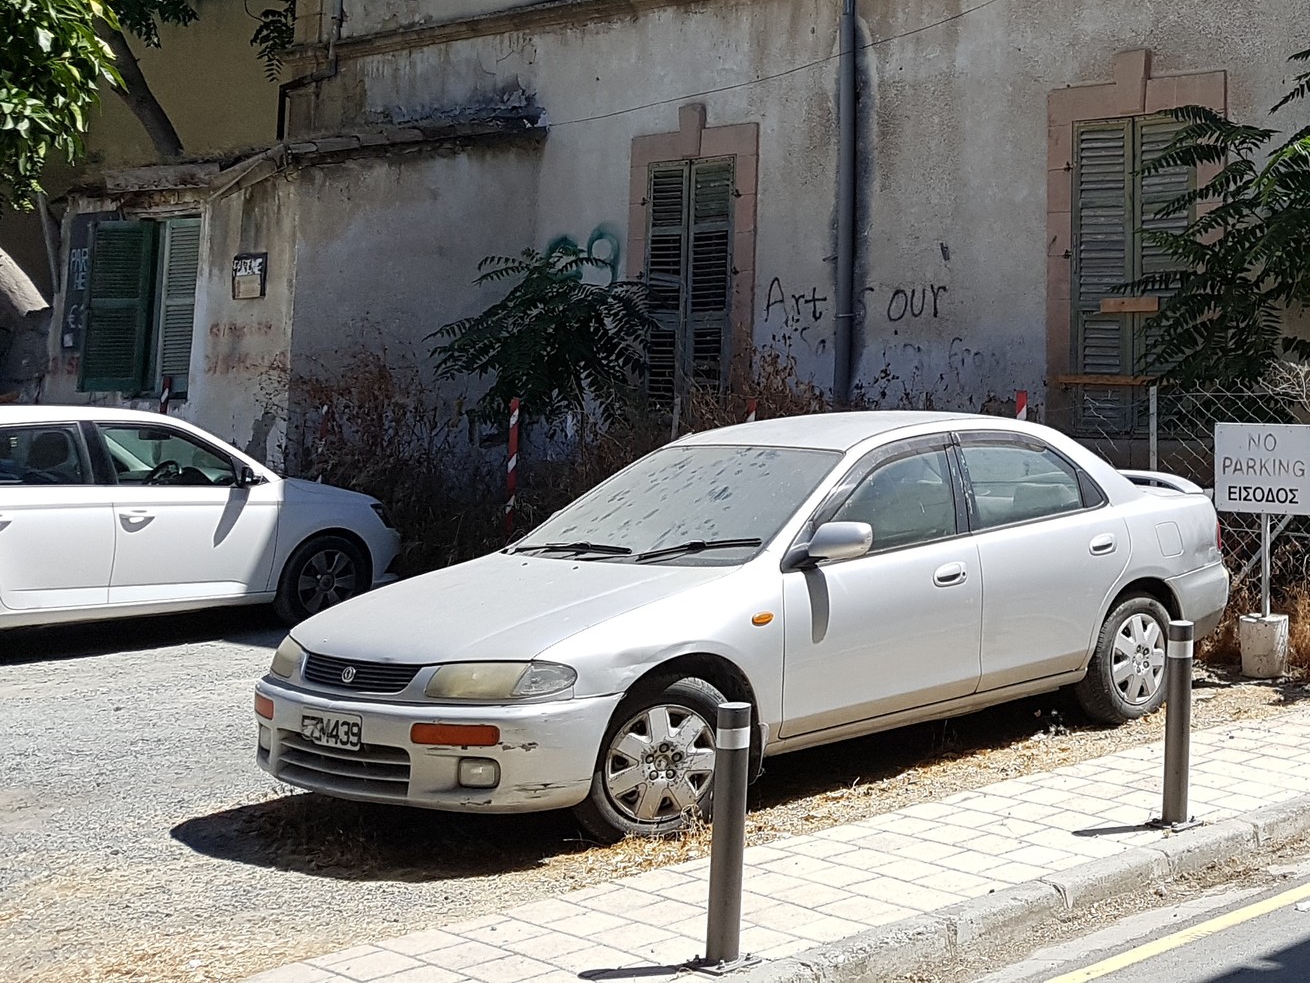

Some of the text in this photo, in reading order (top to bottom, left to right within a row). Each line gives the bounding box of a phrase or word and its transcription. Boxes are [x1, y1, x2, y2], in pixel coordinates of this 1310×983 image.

[764, 276, 828, 322] Art
[887, 284, 948, 322] our
[1247, 432, 1278, 452] NO
[1222, 456, 1306, 479] PARKING
[1227, 485, 1300, 505] ΕΙΣΟΔΟΣ
